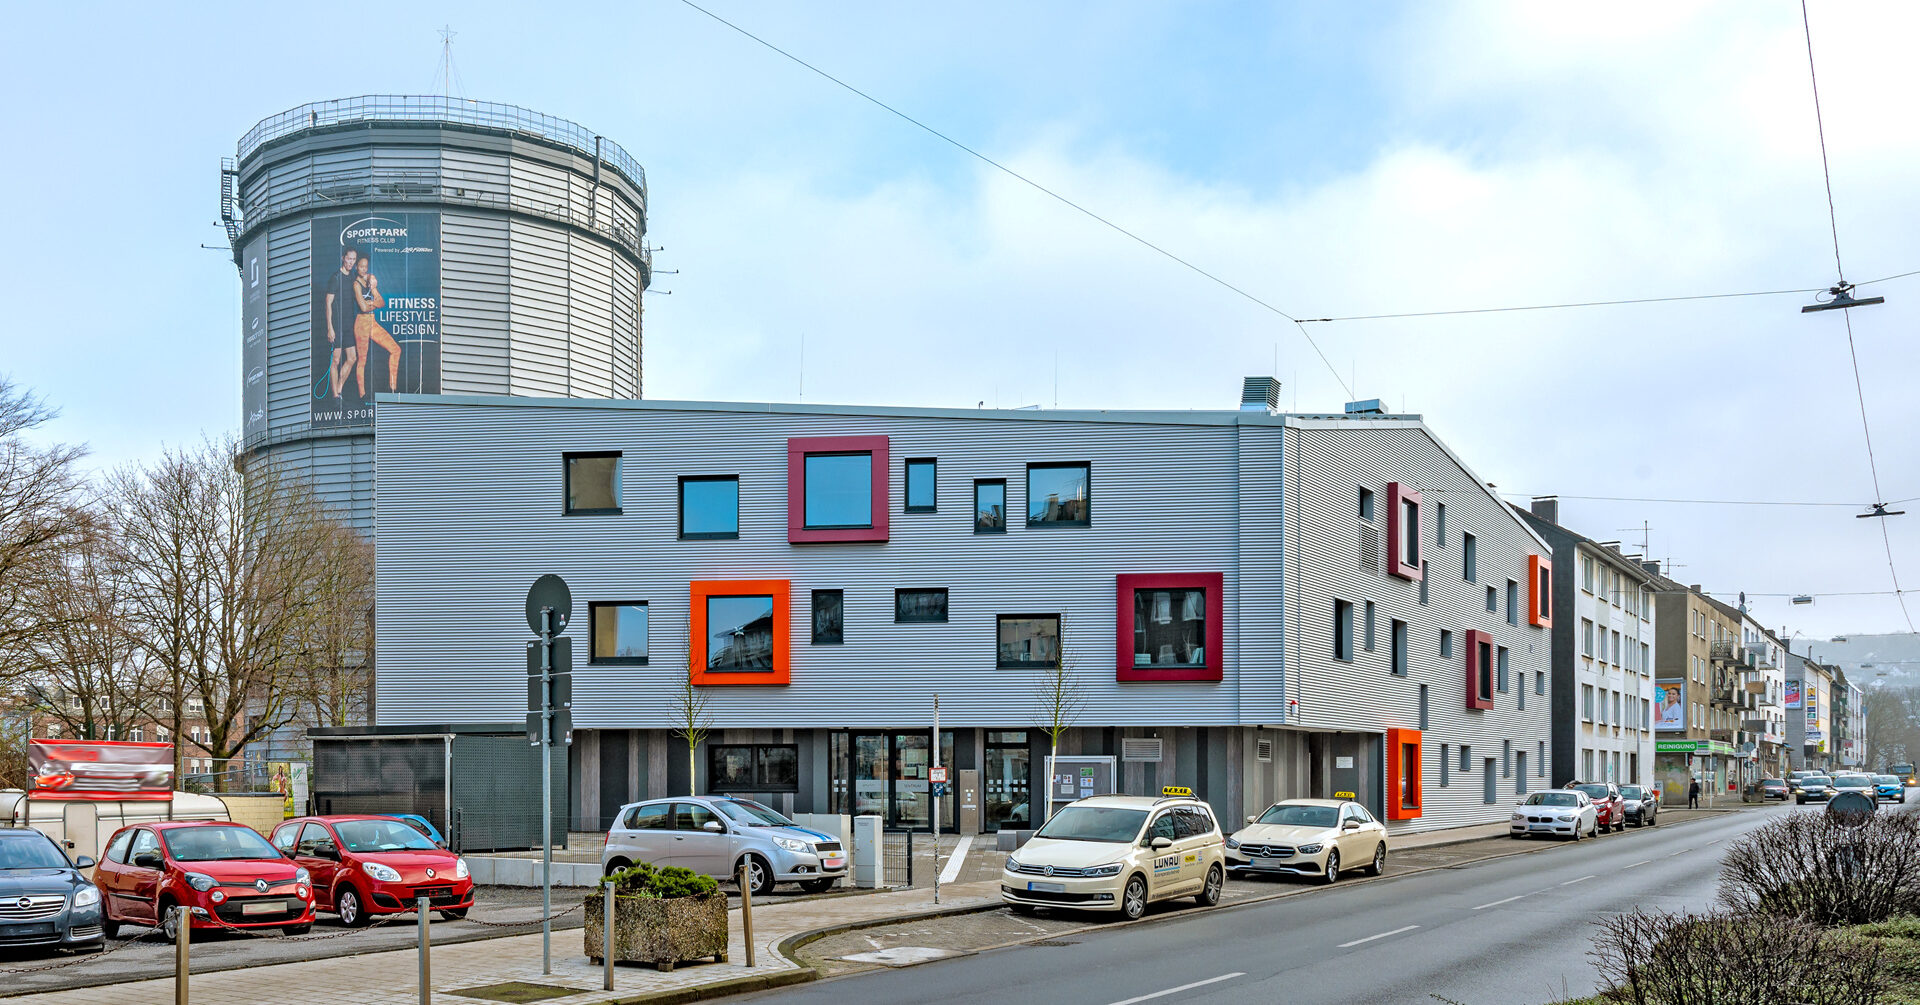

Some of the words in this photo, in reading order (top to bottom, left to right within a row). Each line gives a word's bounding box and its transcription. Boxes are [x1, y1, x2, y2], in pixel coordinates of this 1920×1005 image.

[346, 228, 408, 239] SPORT-PARK
[388, 297, 438, 309] FITNESS.
[380, 310, 438, 322] LIFESTYLE.
[392, 323, 438, 335] DESIGN.
[1154, 856, 1179, 869] LUNAU
